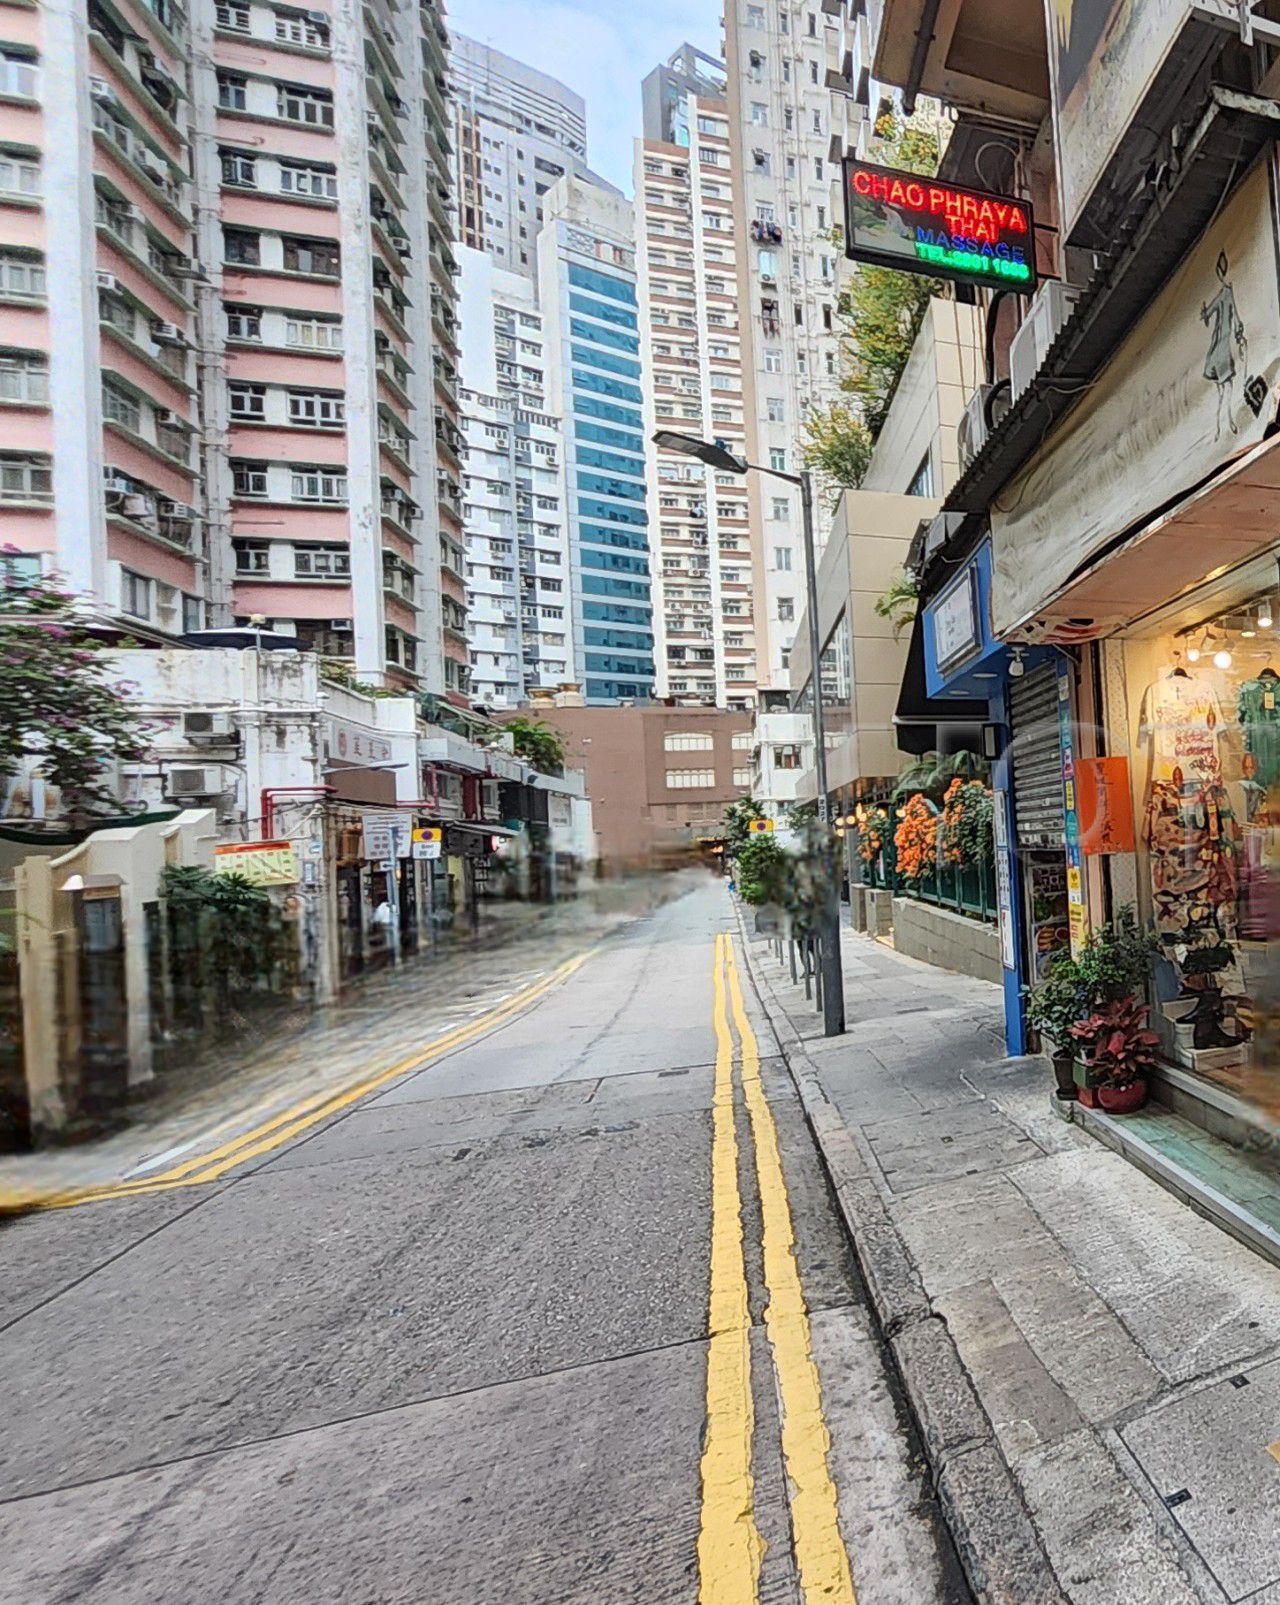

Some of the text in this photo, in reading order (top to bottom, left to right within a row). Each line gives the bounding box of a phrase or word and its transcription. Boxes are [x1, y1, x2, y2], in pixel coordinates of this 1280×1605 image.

[852, 171, 1027, 233] CHAO PHRAYA
[916, 226, 1025, 264] MASSAGE
[945, 214, 997, 241] THAI
